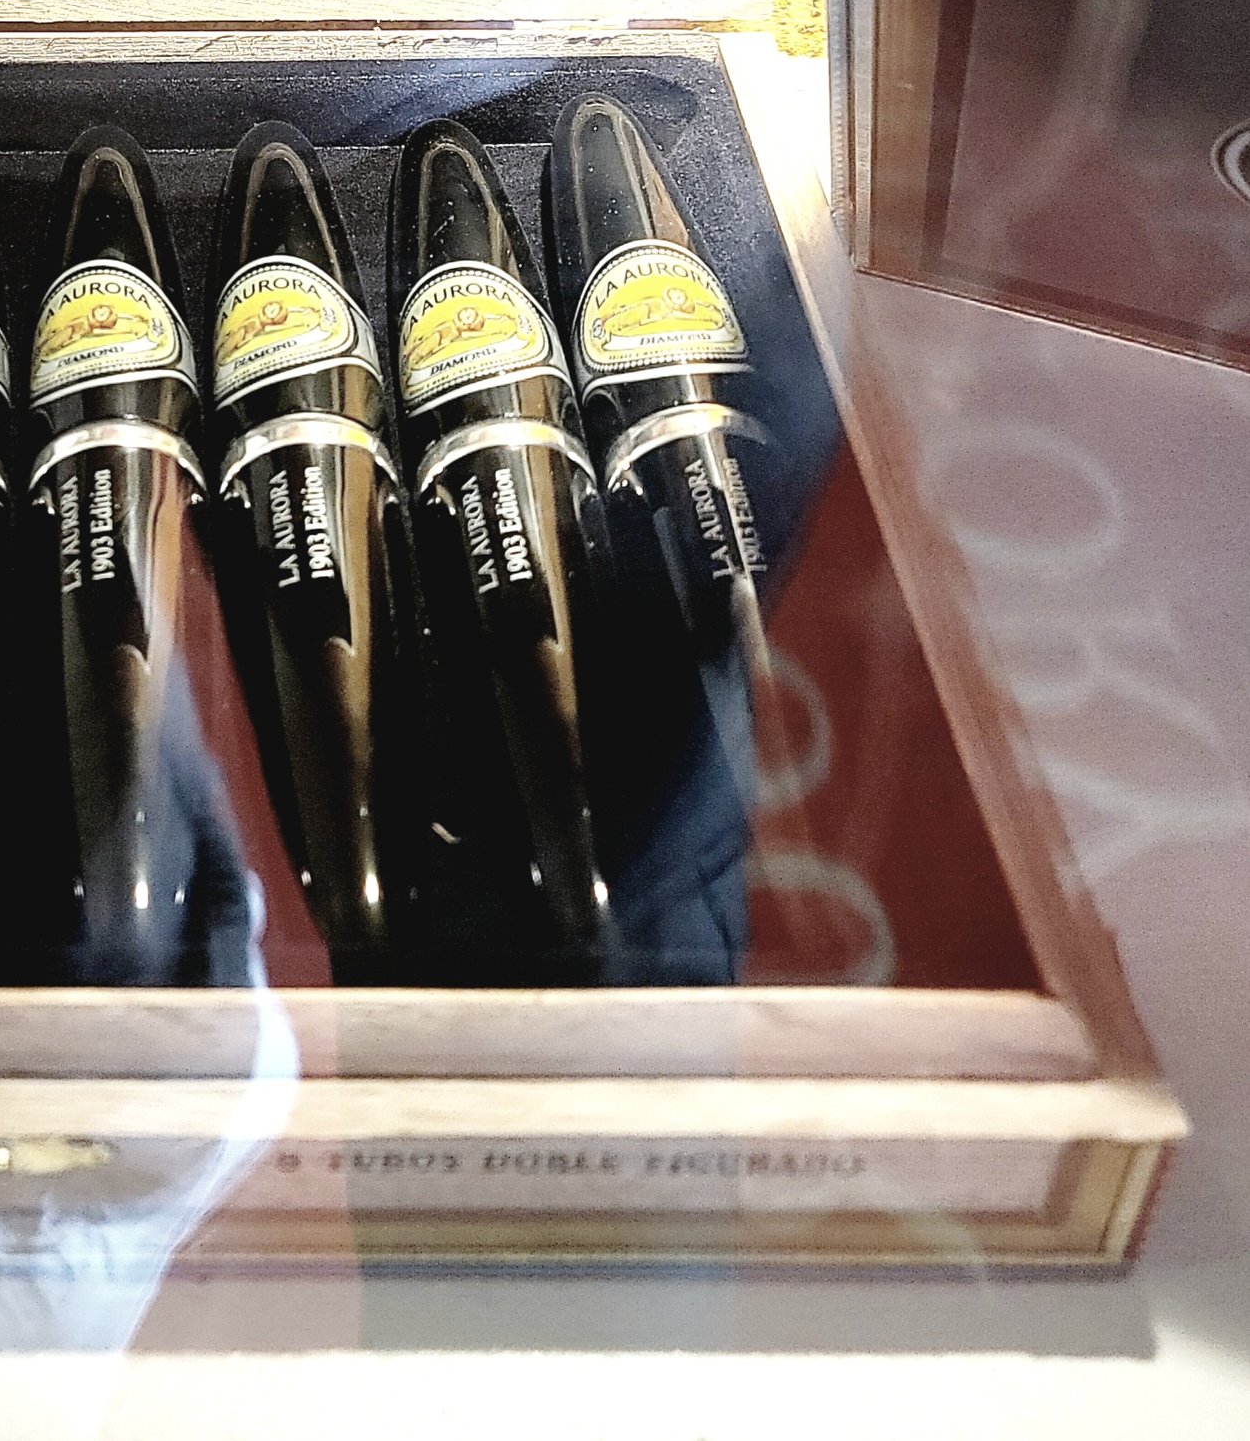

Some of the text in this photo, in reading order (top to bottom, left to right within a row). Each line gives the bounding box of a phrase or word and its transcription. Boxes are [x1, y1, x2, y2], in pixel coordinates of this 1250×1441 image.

[58, 282, 152, 311] AURORA
[231, 277, 322, 309] AURORA
[420, 281, 516, 313] AURORA
[594, 280, 619, 310] LA
[57, 346, 125, 368] DIAMOND
[234, 340, 298, 370] DIAMOND
[429, 346, 498, 376] DIAMOND
[61, 475, 83, 593] LA AURORA
[90, 469, 115, 581] 1903 Edition
[269, 470, 301, 588] LA AURORA
[304, 467, 335, 578] 1903 Edition
[463, 476, 499, 594] LA AURORA
[494, 467, 532, 581] 1903 Edition
[686, 459, 735, 579] LA AURORA
